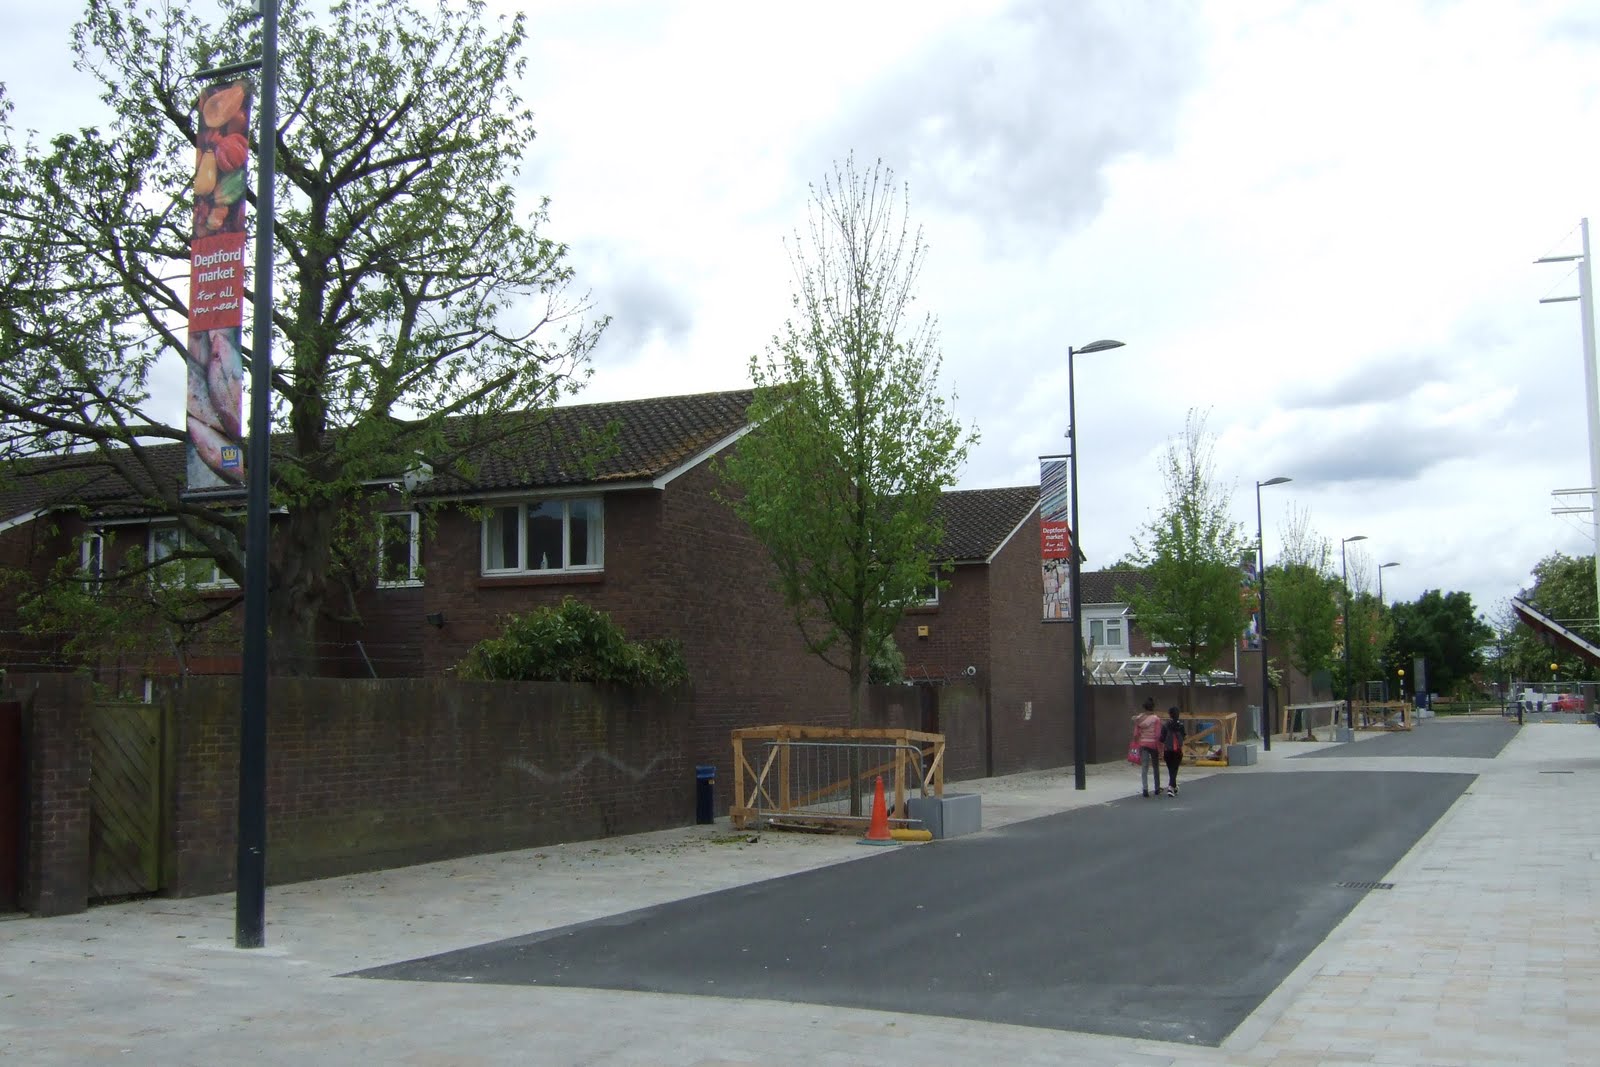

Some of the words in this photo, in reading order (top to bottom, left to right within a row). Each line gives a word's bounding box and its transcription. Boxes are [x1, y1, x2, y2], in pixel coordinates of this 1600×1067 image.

[194, 247, 241, 268] Deptford
[198, 266, 235, 283] market
[197, 290, 216, 301] for
[219, 286, 235, 298] all
[193, 306, 209, 317] you
[212, 298, 239, 311] need
